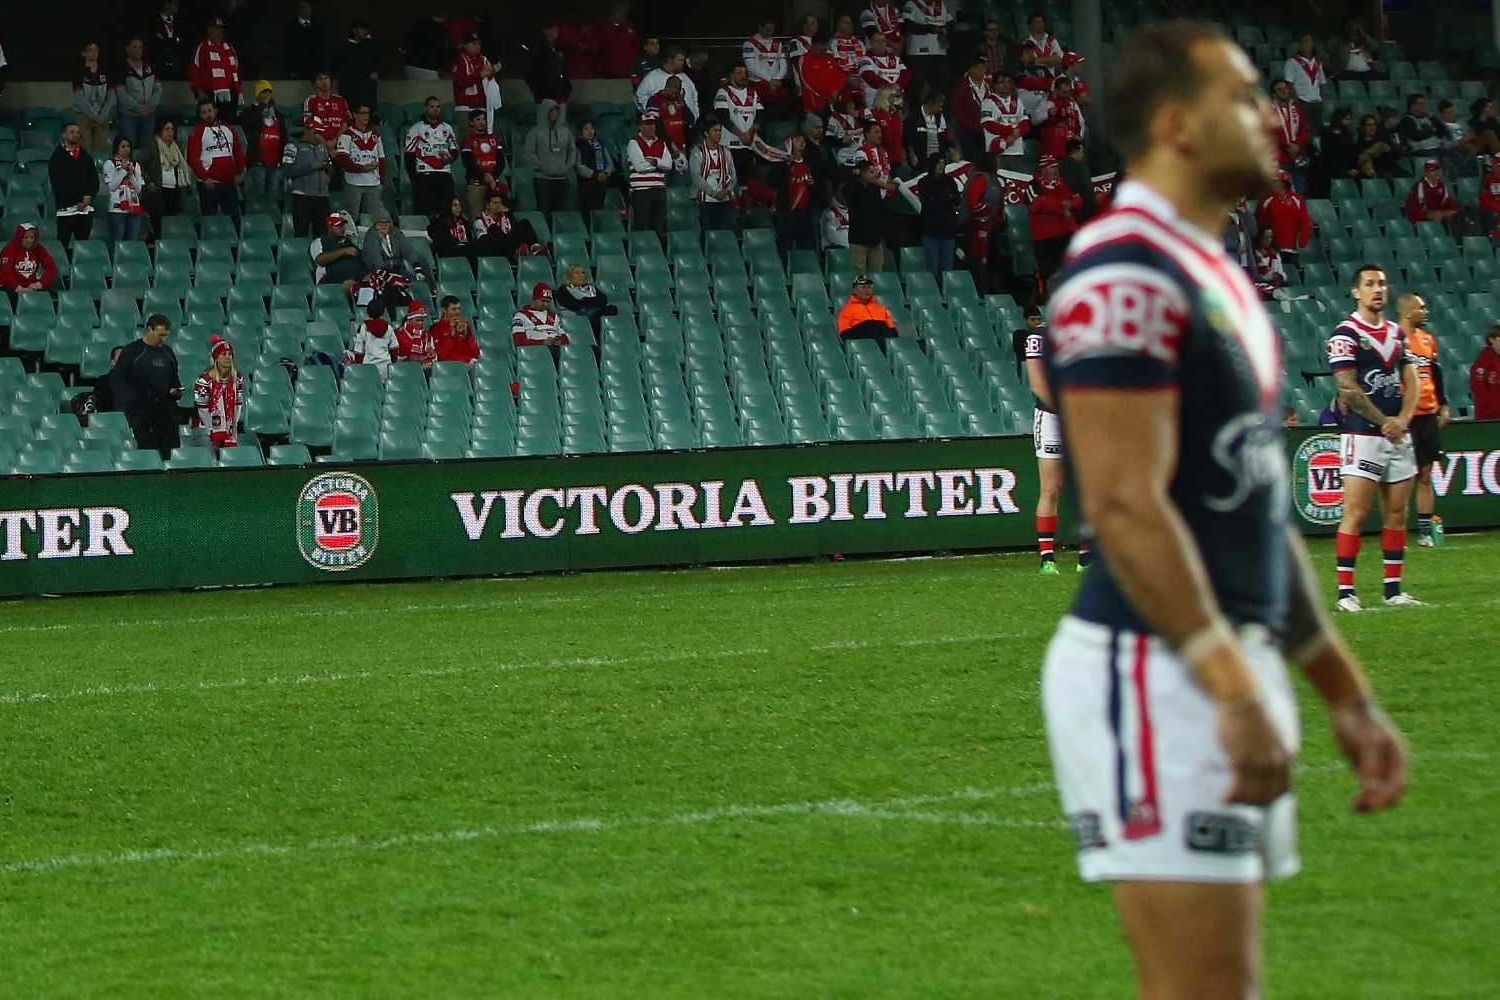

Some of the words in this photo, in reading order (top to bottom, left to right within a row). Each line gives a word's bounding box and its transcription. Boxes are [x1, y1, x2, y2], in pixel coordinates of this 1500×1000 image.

[316, 508, 359, 534] VB
[450, 479, 775, 541] VICTORIA
[787, 468, 1020, 525] BITTER
